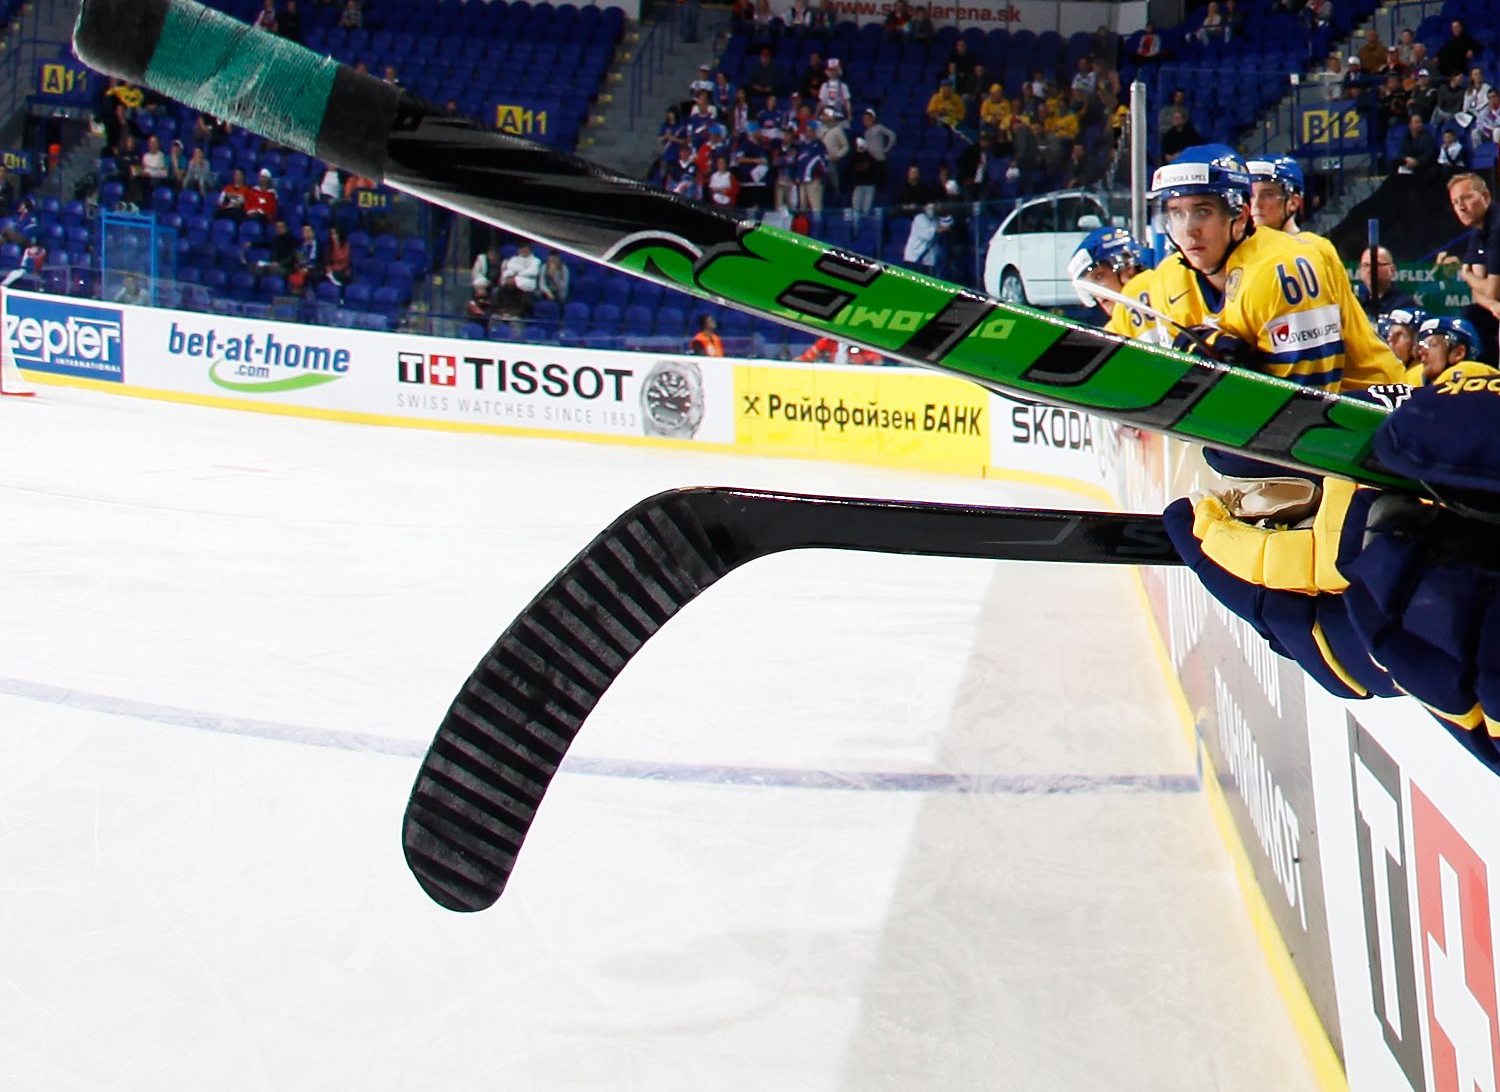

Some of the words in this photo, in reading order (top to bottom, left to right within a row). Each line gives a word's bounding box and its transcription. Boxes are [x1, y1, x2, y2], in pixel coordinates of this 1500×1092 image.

[825, 0, 1021, 24] www.slarena.sk
[1276, 257, 1320, 306] 60
[5, 314, 121, 363] zepter
[168, 322, 350, 373] bet-at-home
[55, 358, 121, 373] INTERNATIONAL
[234, 364, 269, 378] .com
[464, 356, 633, 401] TISSOT
[396, 394, 449, 412] SWISS
[456, 398, 536, 419] WATCHES
[545, 405, 593, 424] SINCE
[602, 411, 636, 427] 1853
[768, 394, 916, 433] Райффайзен
[924, 404, 983, 436] БАНК
